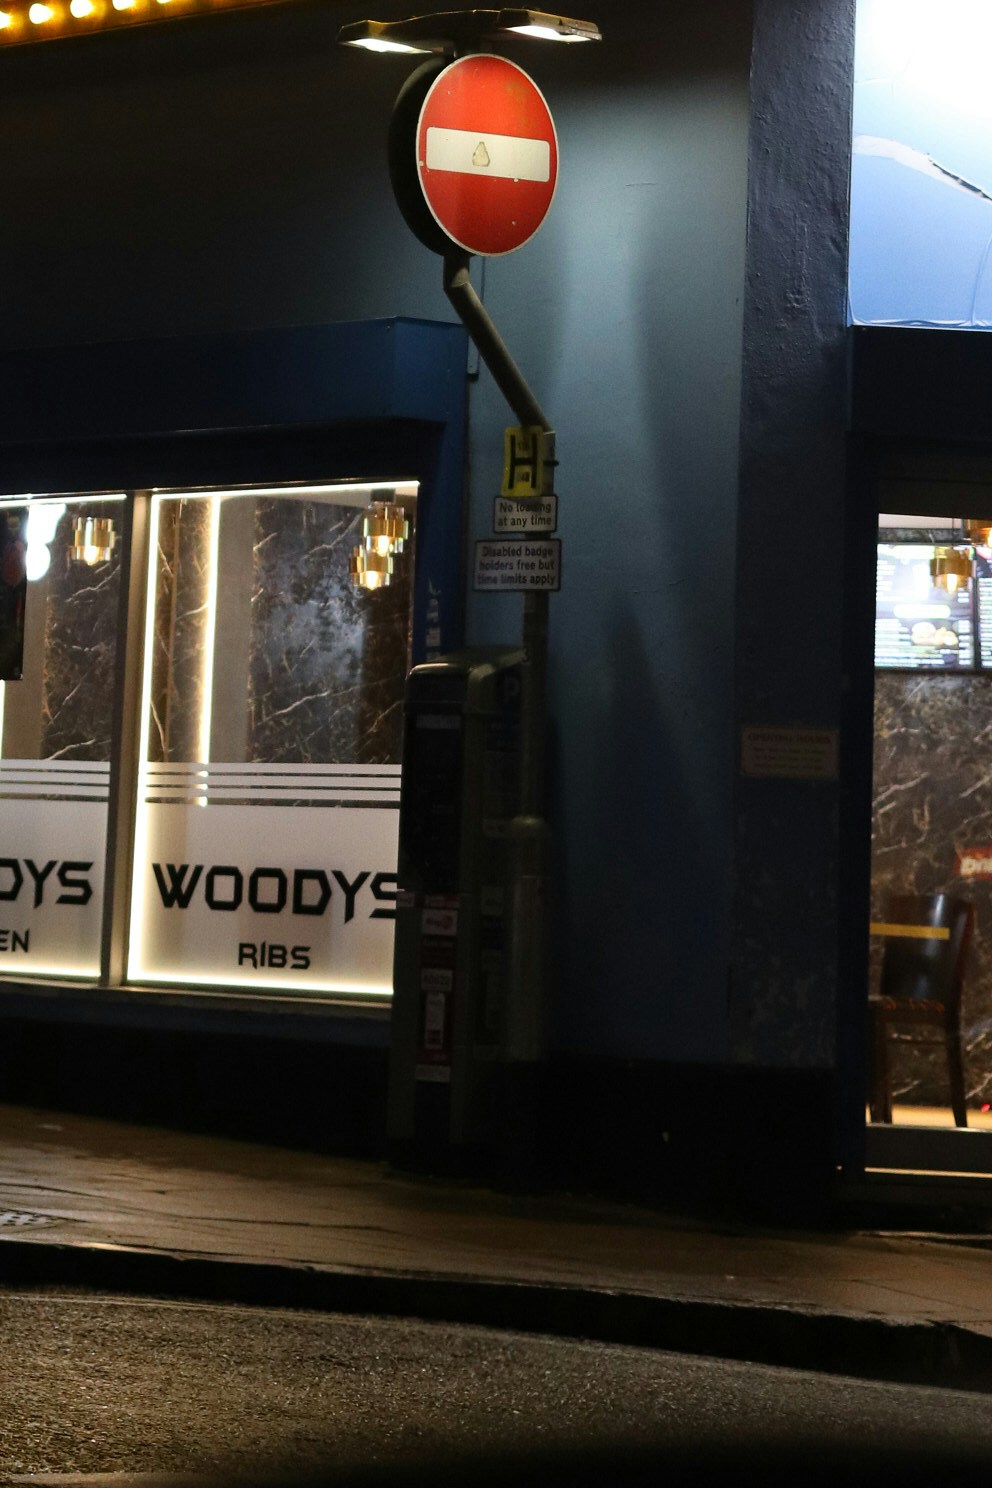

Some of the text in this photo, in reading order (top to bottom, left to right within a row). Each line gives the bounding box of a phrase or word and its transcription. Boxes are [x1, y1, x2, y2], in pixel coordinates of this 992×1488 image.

[508, 434, 537, 489] H
[499, 502, 513, 512] No
[498, 514, 552, 527] at any time
[482, 545, 553, 558] Disabled badge
[479, 560, 554, 570] holders free but
[477, 573, 555, 586] time limits apply
[238, 941, 311, 970] RIBS
